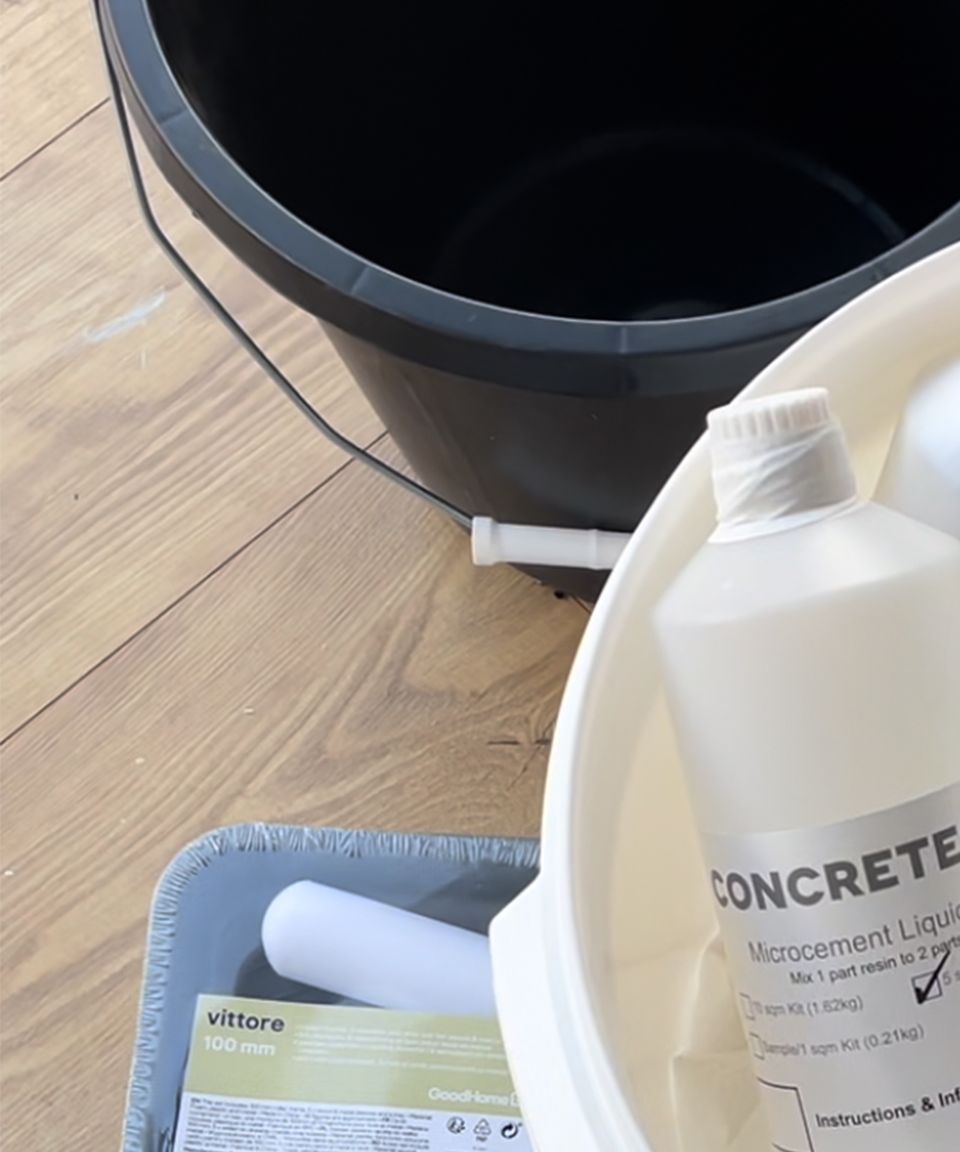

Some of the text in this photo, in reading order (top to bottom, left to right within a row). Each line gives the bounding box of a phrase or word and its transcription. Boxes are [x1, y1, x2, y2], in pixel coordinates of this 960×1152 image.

[748, 924, 894, 963] Microcement
[789, 970, 815, 986] Mix
[817, 969, 826, 983] 1
[829, 963, 858, 986] part
[860, 957, 896, 976] resin
[900, 953, 916, 968] to
[918, 948, 930, 963] 2
[788, 1002, 805, 1015] Kit
[806, 995, 864, 1017] (1.62kg)
[207, 1008, 285, 1033] vittore
[203, 1035, 276, 1056] 100 mm
[810, 1043, 839, 1057] sqm
[840, 1038, 861, 1052] Kit
[863, 1023, 925, 1051] (0.21kg)
[428, 1087, 510, 1107] GoodHome
[815, 1103, 917, 1129] Instructions
[921, 1098, 935, 1113] &
